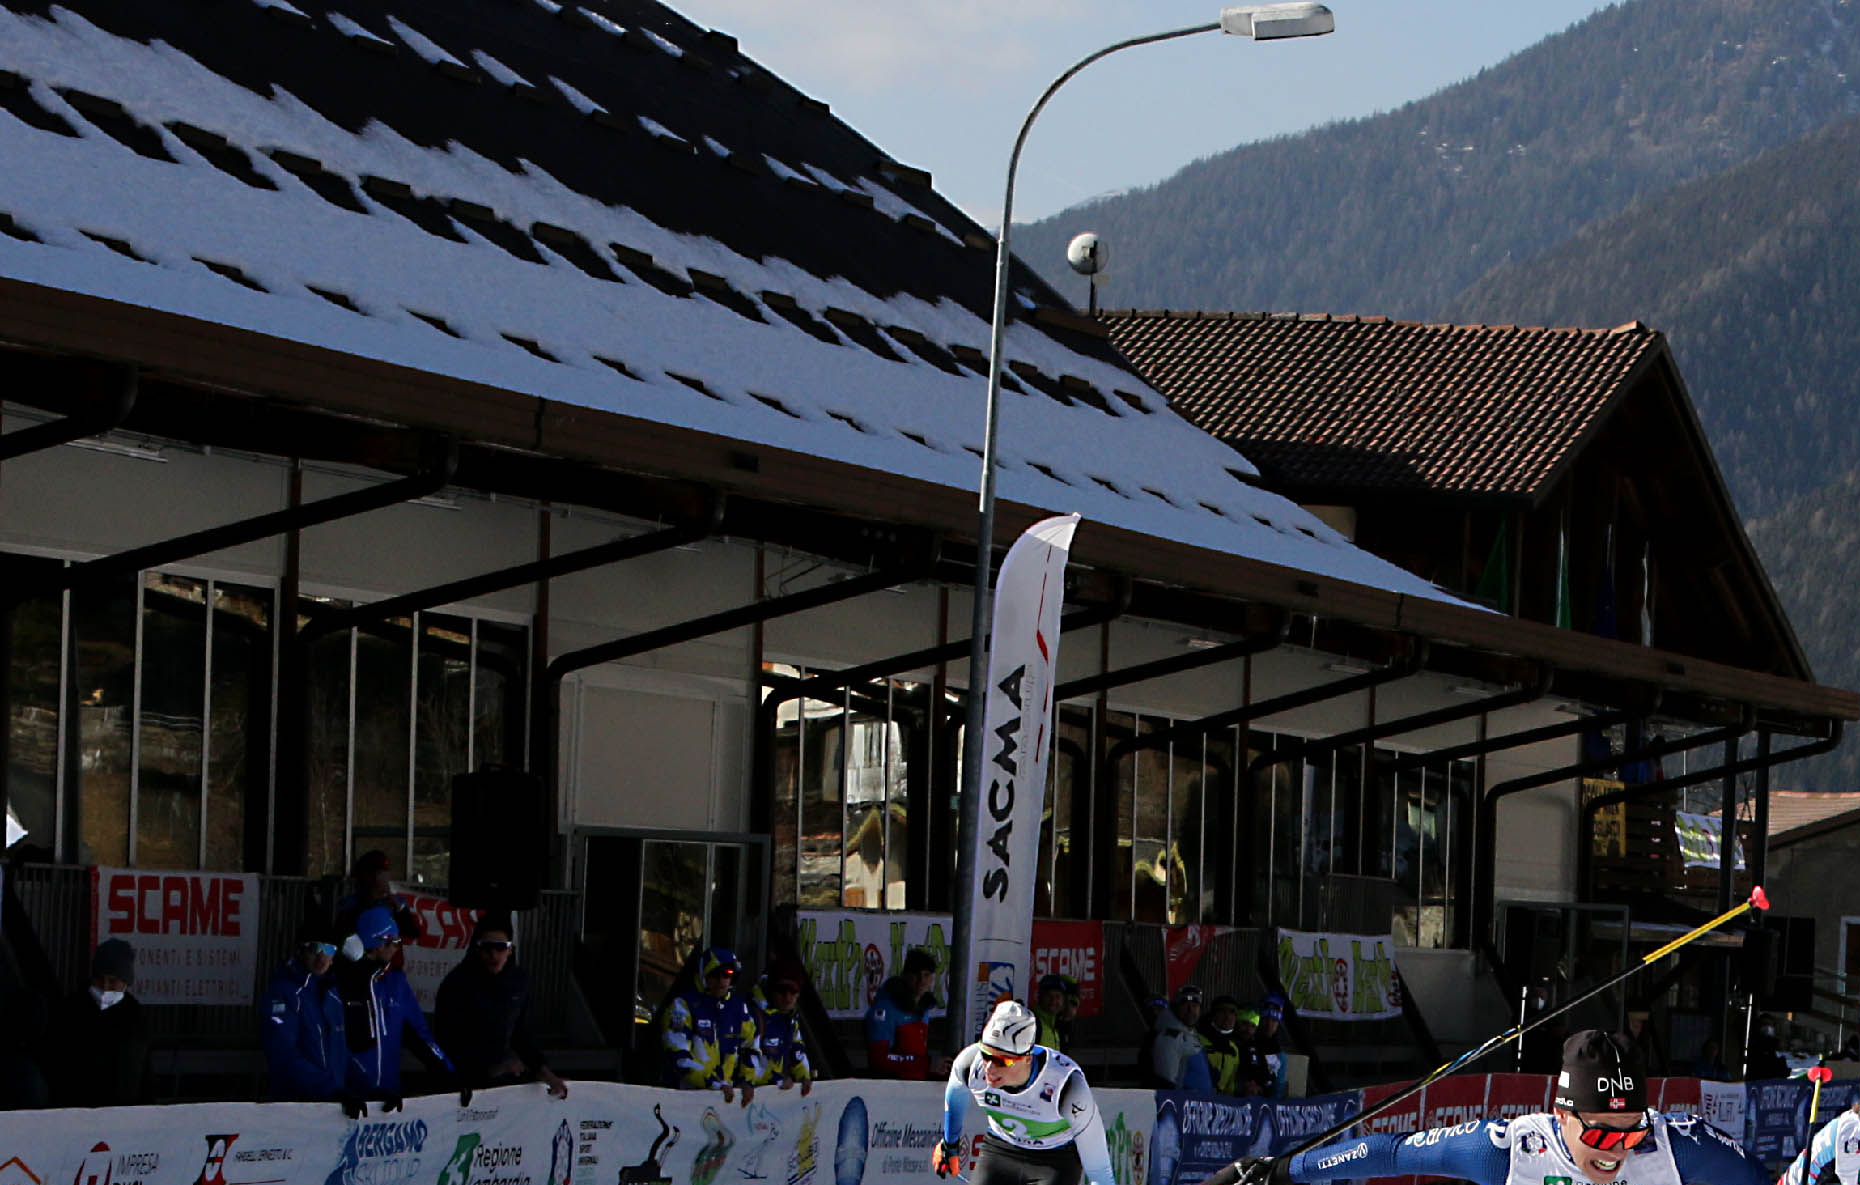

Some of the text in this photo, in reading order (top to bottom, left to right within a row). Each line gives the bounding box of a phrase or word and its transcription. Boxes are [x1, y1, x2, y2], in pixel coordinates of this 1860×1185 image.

[982, 664, 1026, 903] SACMA
[109, 875, 243, 937] SCAME
[1035, 948, 1095, 981] SCAME
[1597, 1062, 1634, 1097] DNB
[356, 1119, 427, 1158] BERGAMO
[475, 1144, 522, 1172] Regione
